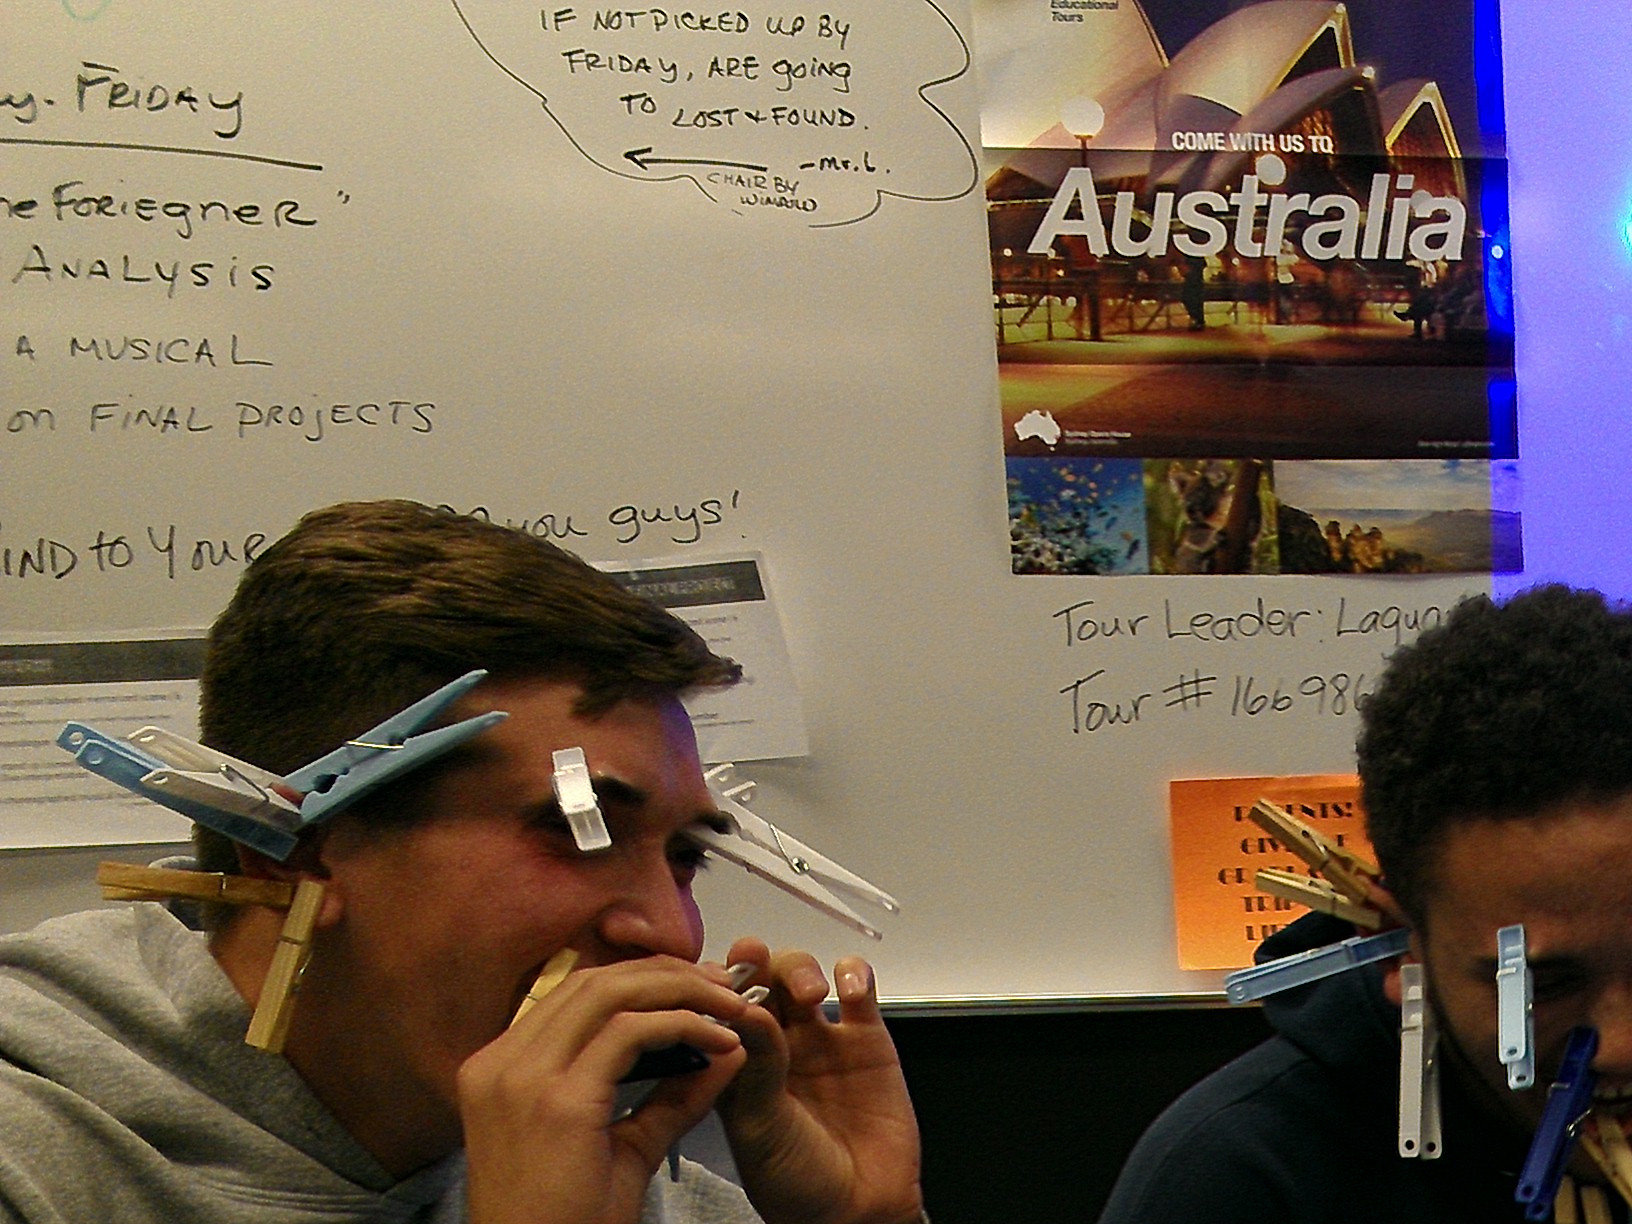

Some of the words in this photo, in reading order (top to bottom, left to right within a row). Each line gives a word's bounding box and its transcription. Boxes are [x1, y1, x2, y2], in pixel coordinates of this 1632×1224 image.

[541, 8, 576, 31] IF
[593, 9, 644, 31] NOT
[655, 10, 749, 34] PICKED
[767, 15, 805, 36] UP
[1051, 11, 1084, 22] Tours
[708, 57, 760, 79] ARE
[620, 93, 657, 115] TO
[672, 107, 738, 128] LOST
[1171, 131, 1225, 151] COME
[1229, 132, 1275, 152] WITH
[1280, 134, 1304, 153] US
[706, 172, 767, 190] CHAIR
[773, 175, 801, 196] BY
[1028, 167, 1467, 261] Australia
[15, 334, 35, 361] A
[69, 334, 274, 368] MUSICAL
[6, 408, 55, 433] on
[90, 403, 213, 434] FINAL
[236, 402, 435, 442] PROJECTS
[88, 531, 134, 571] to
[1052, 600, 1149, 647] Tour
[1336, 597, 1450, 660] Lagua
[1059, 670, 1151, 734] Tour
[1162, 668, 1217, 711] #
[1233, 802, 1353, 822] PENTS!
[1240, 837, 1293, 855] GIV
